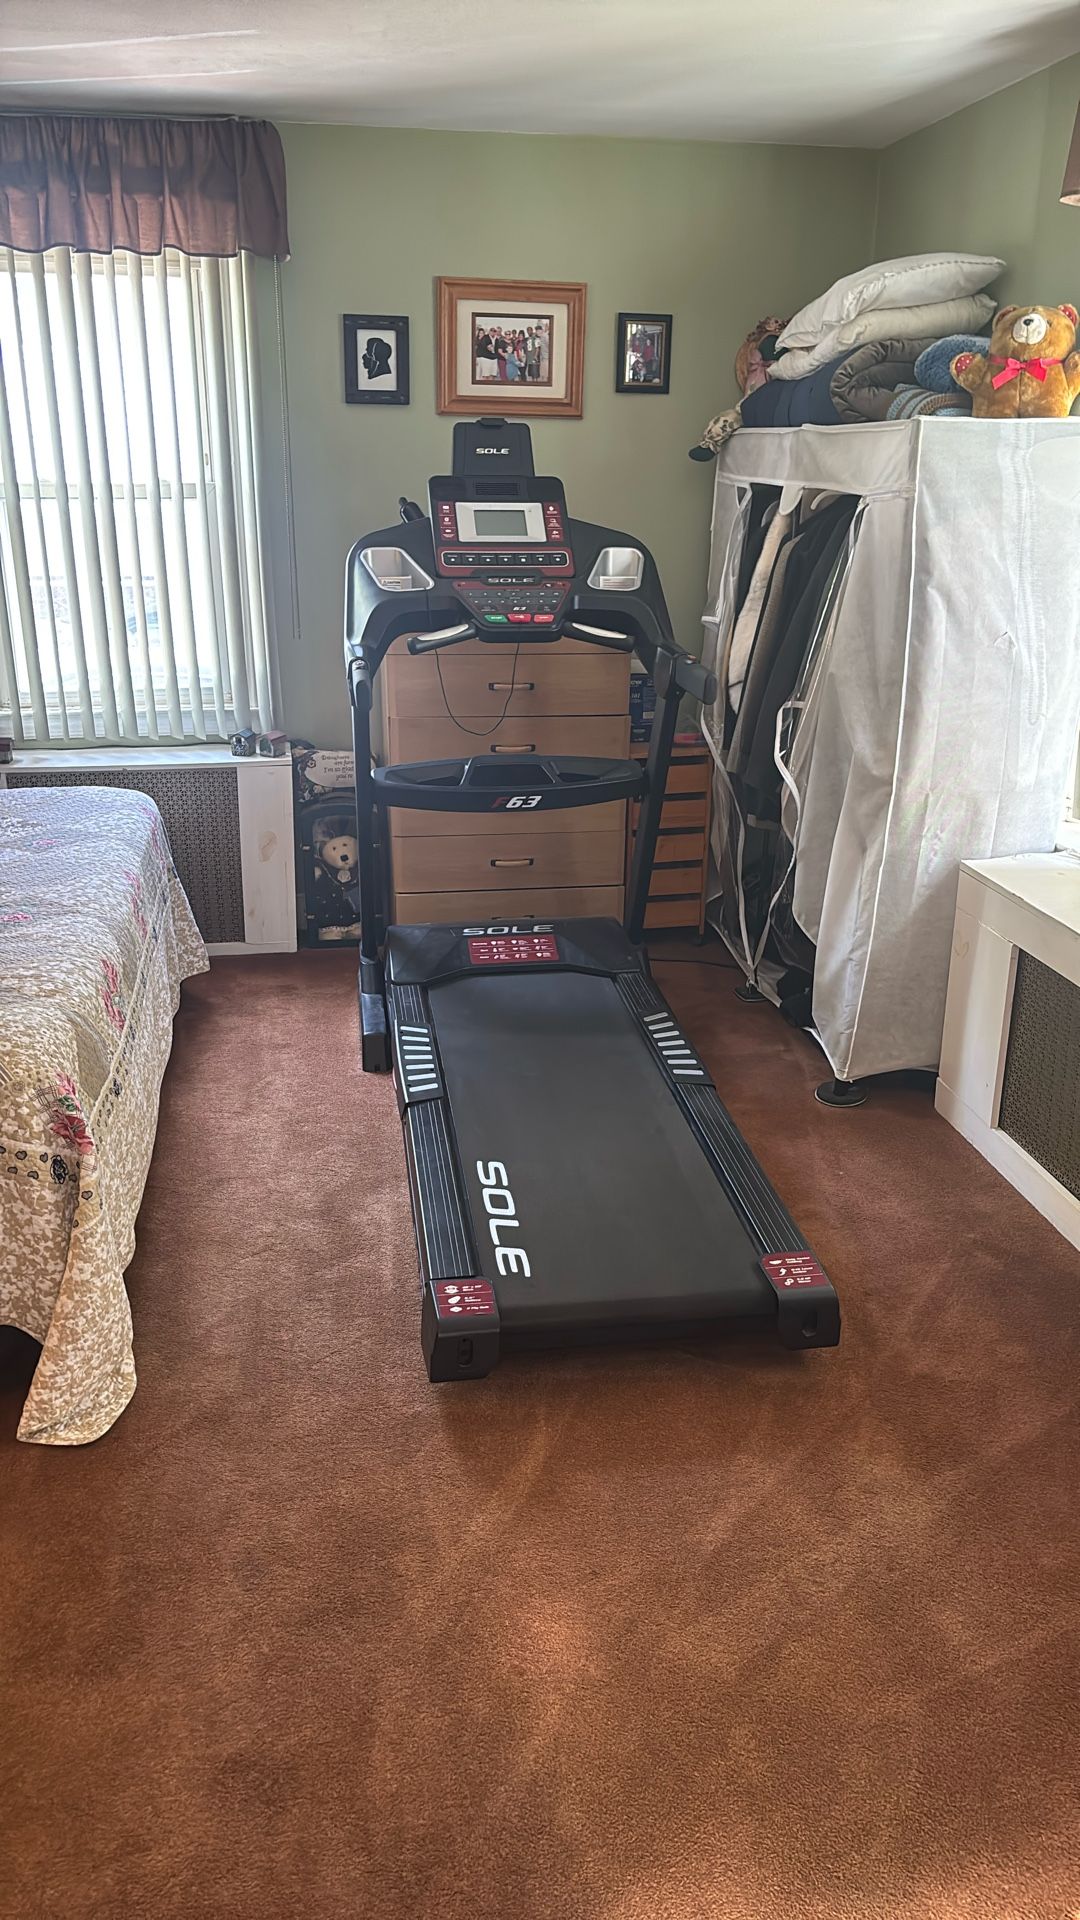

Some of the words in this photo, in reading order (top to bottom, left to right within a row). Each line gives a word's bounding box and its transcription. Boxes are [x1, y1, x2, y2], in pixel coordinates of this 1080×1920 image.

[475, 447, 510, 455] SOLE
[491, 796, 542, 808] F63
[462, 924, 554, 936] SOLE
[476, 1160, 531, 1278] SOLE
